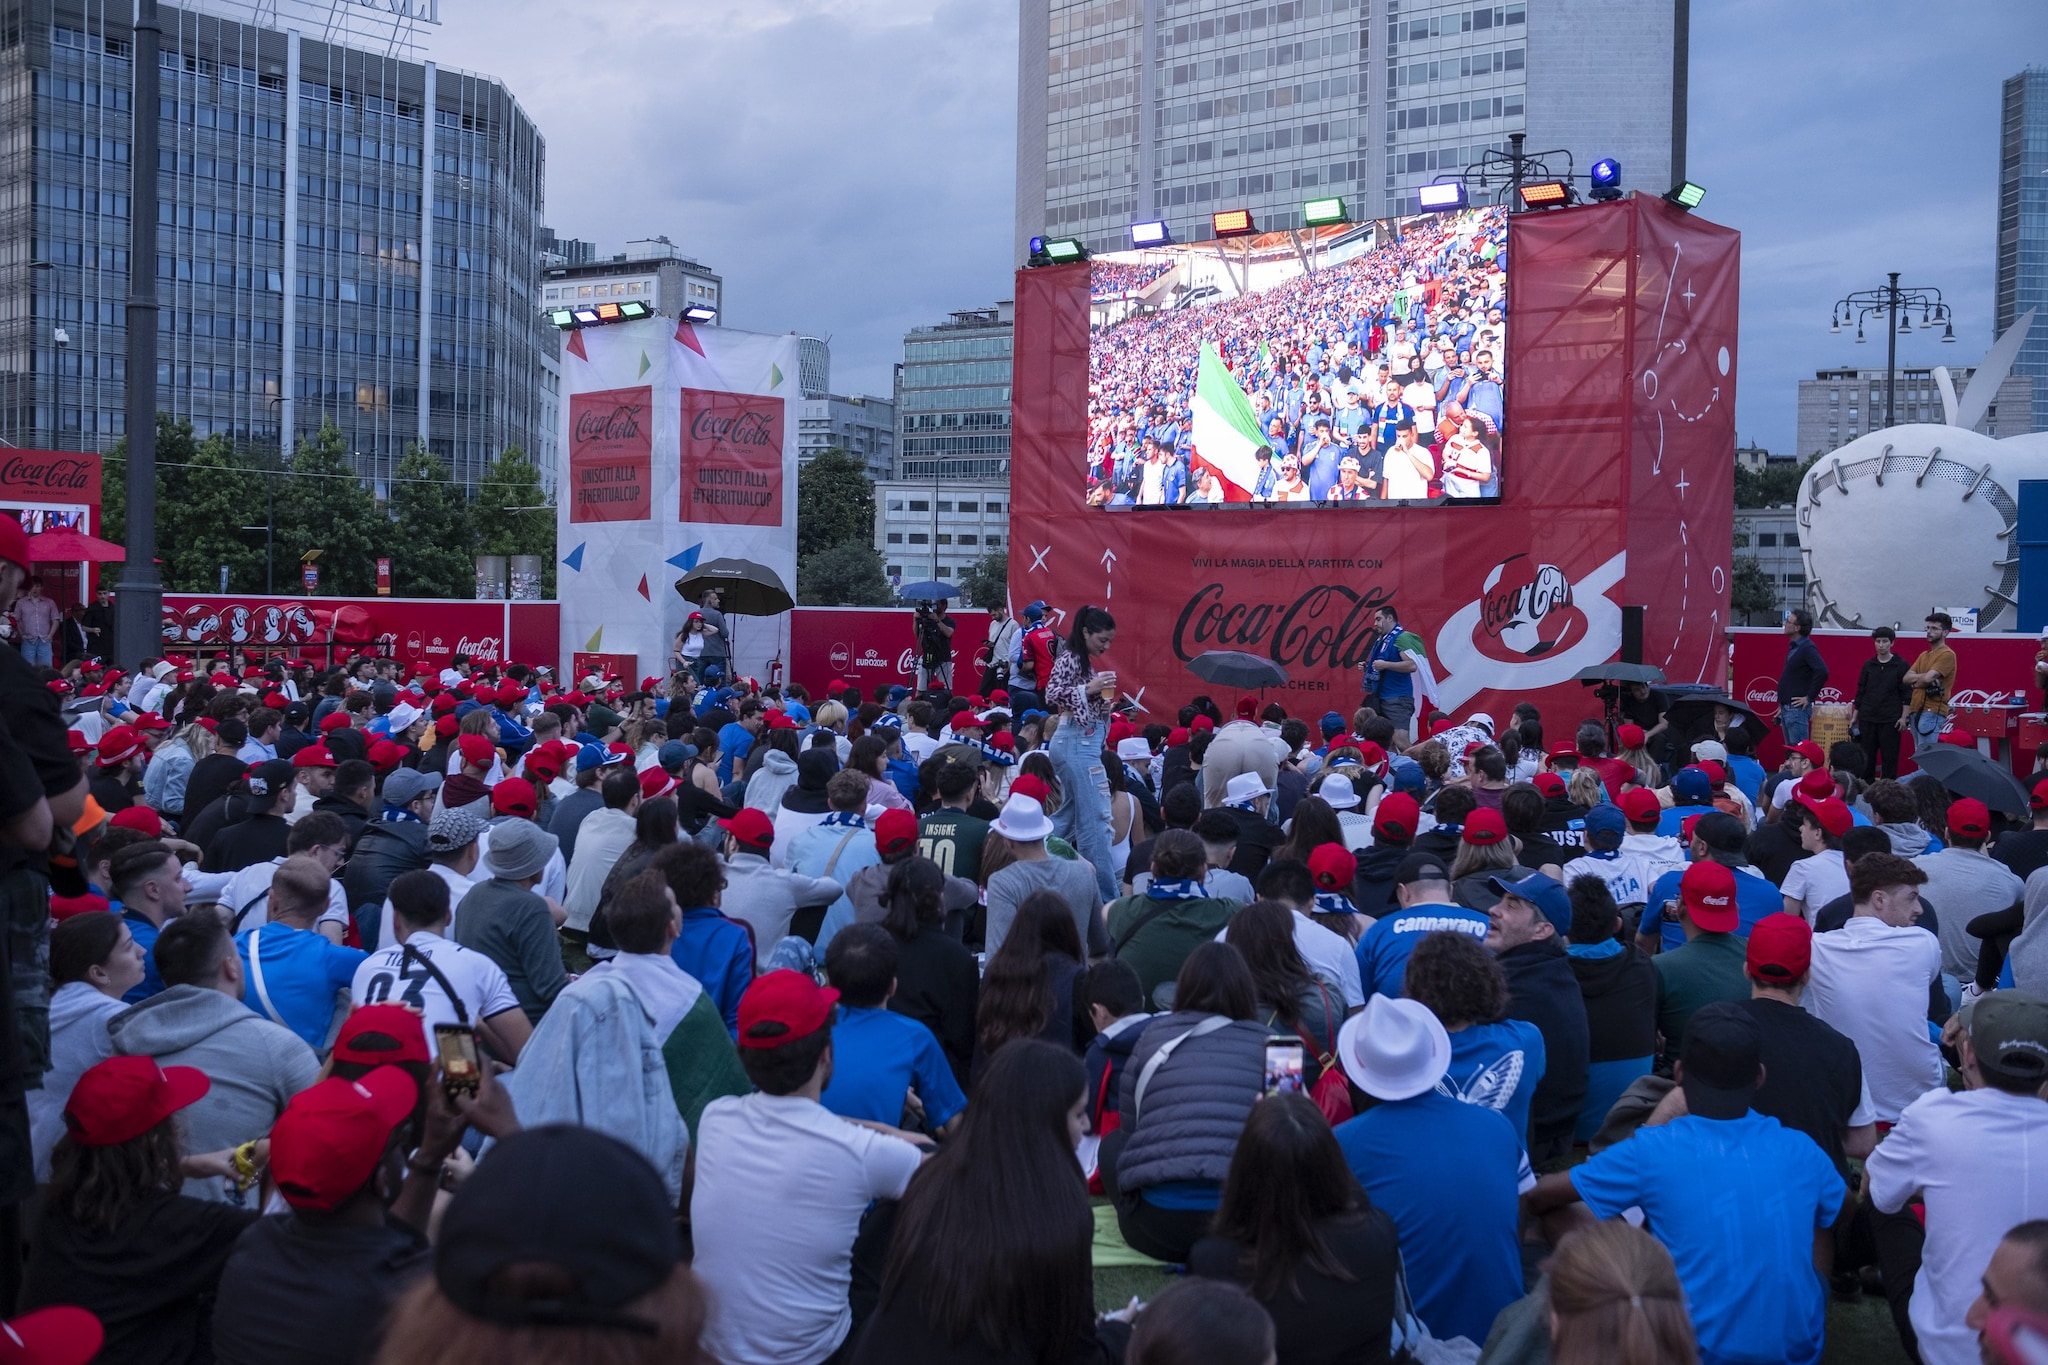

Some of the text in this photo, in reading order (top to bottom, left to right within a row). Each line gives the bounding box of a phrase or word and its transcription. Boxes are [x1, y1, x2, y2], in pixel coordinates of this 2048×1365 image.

[576, 404, 641, 443] Coca-Cola
[691, 408, 775, 446] Coca-Cola
[1, 456, 94, 489] Coca-Cola
[582, 466, 636, 484] UNISCITI ALLA
[698, 468, 768, 487] UNISCITI ALLA
[578, 485, 641, 505] #THERITUALCUP
[692, 488, 773, 507] #THERITUALCUP
[1192, 558, 1383, 569] VIVI LA MAGIA DELLA PARTITA CON
[1172, 583, 1399, 669] Coca-Cola
[456, 636, 501, 661] Coca-Cola
[856, 658, 887, 667] EURO2024
[1268, 680, 1330, 691] CHERI
[924, 823, 958, 837] INSIGNE
[920, 838, 956, 876] 10
[1393, 916, 1487, 937] cannavaro
